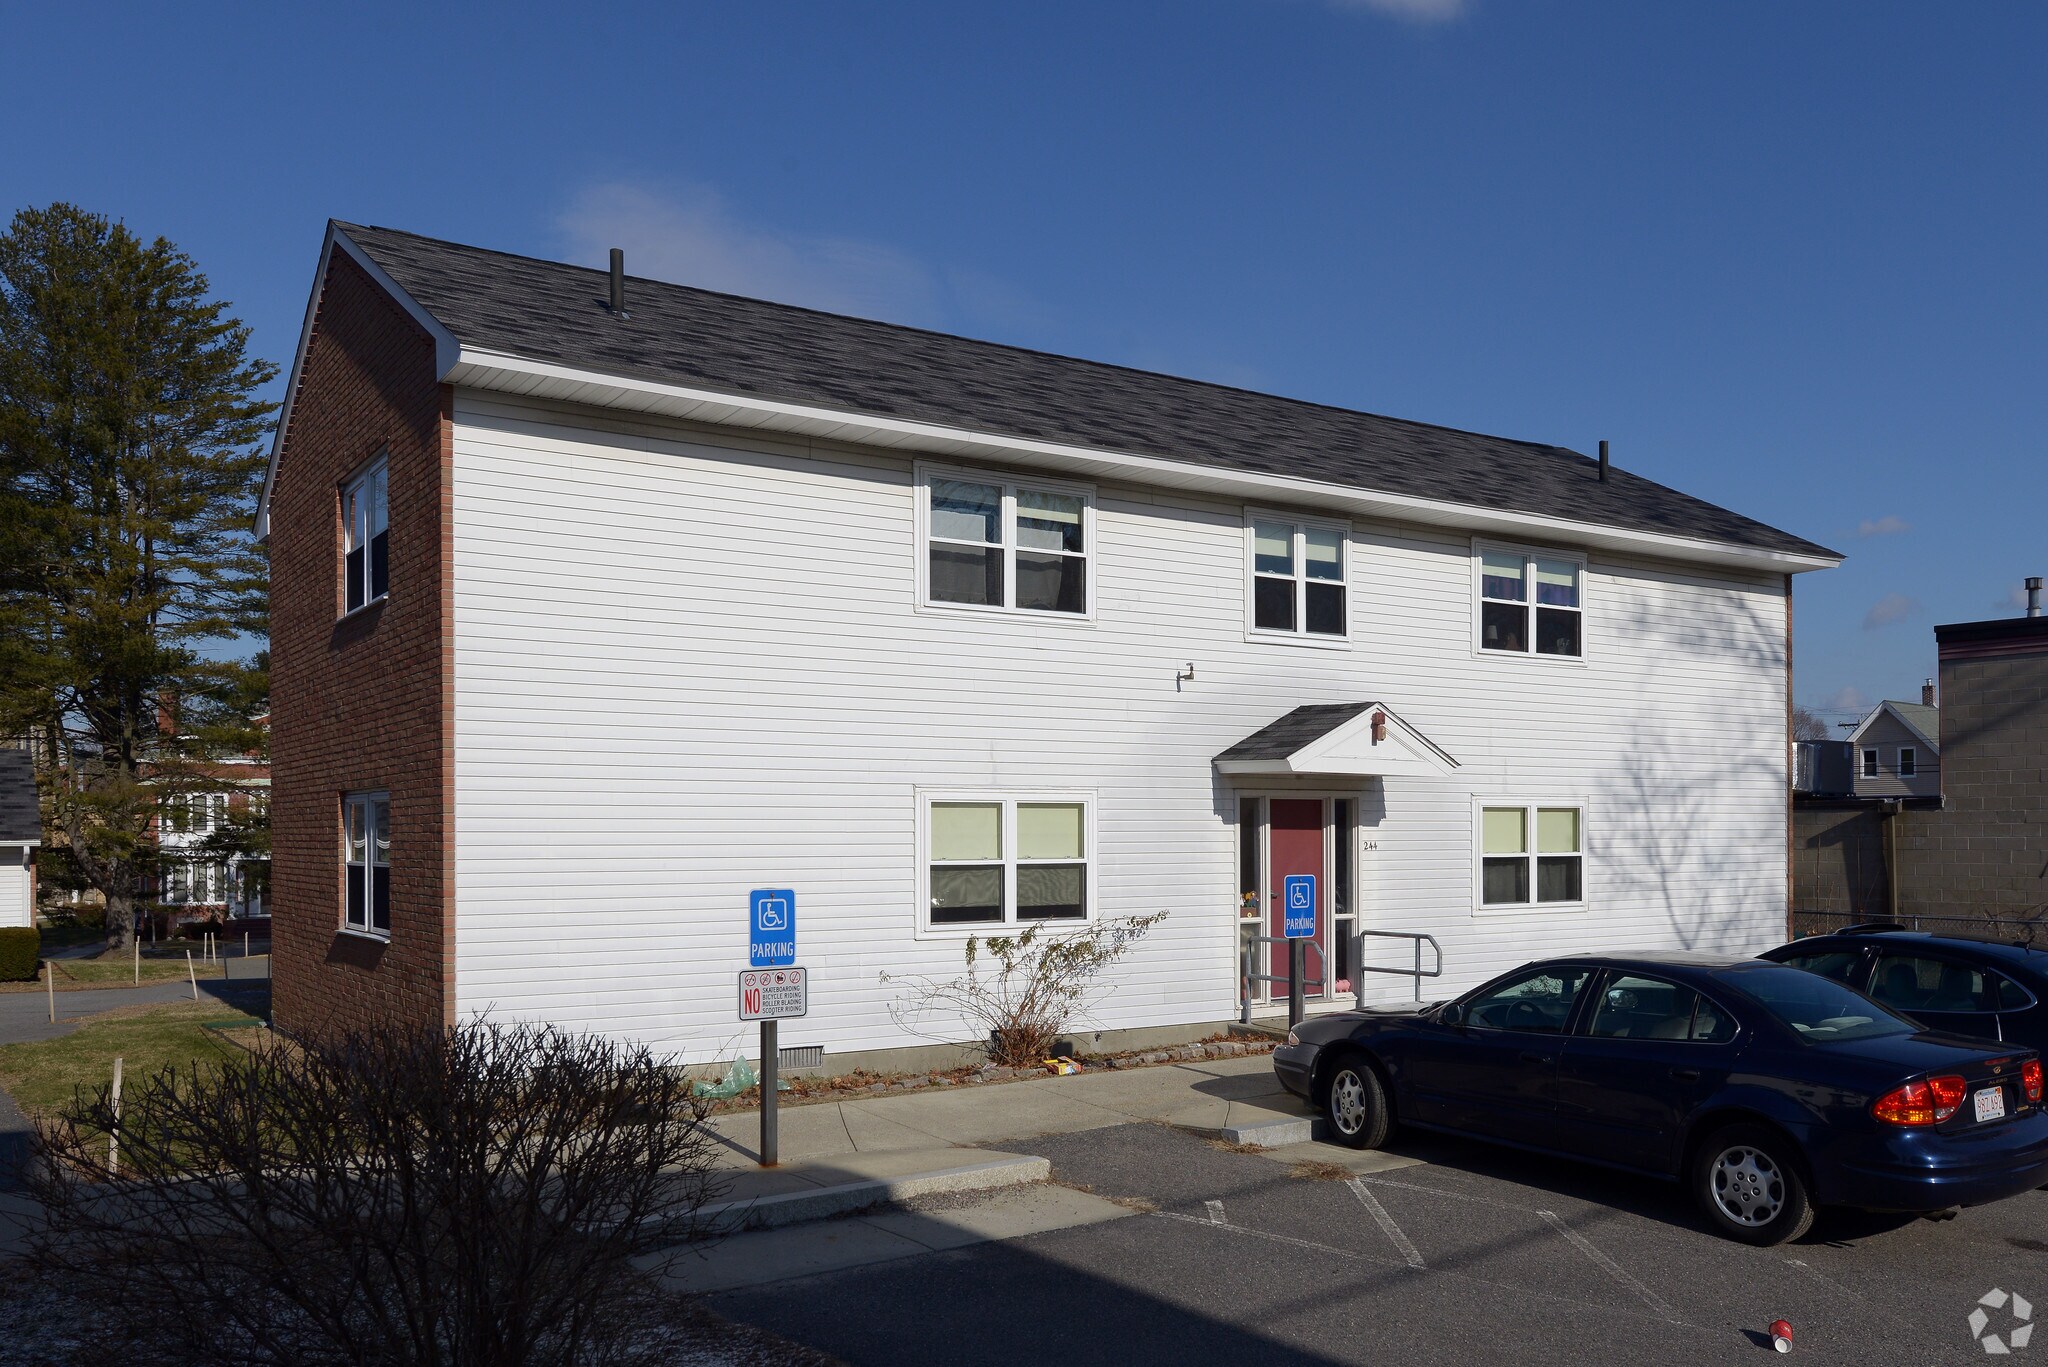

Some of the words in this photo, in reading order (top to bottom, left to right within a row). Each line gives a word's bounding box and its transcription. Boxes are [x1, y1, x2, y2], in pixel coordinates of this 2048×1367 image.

[1363, 841, 1378, 850] 244
[1286, 917, 1314, 930] PARKING
[751, 941, 794, 958] PARKING
[762, 985, 800, 993] SKATEBOARDING
[744, 988, 761, 1015] NO
[762, 1006, 784, 1014] SCOOTER
[1988, 1077, 2008, 1086] ALERO
